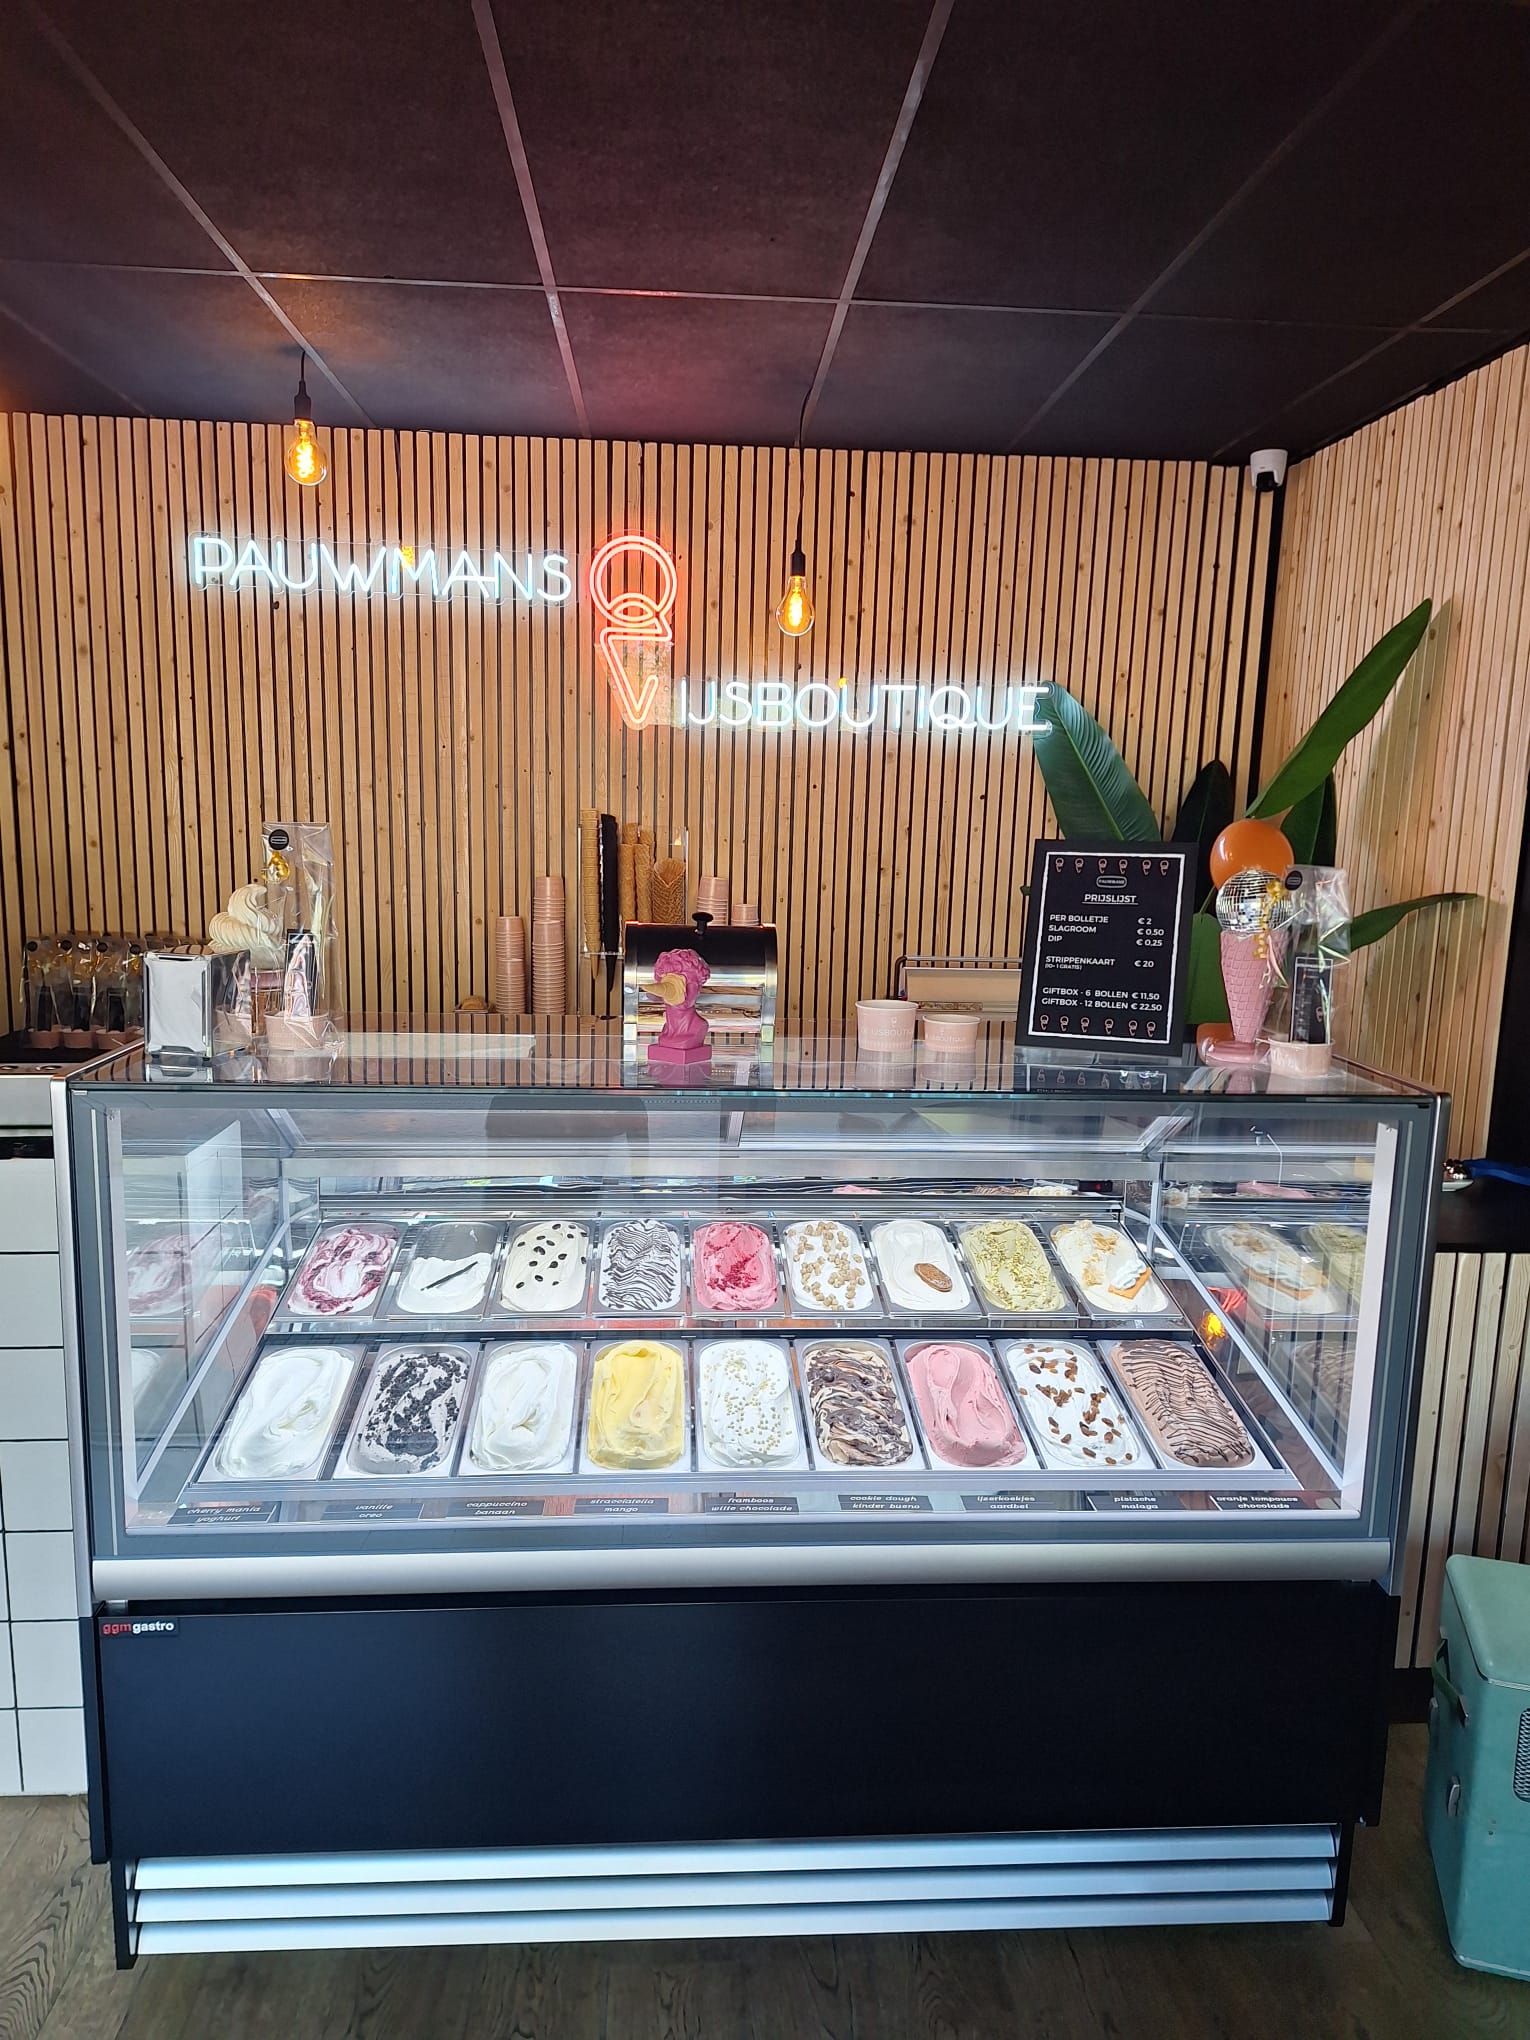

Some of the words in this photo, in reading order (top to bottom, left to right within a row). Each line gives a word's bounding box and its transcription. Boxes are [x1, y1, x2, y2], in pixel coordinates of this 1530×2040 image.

[192, 536, 573, 602] PAUWMANS
[680, 677, 1051, 732] IJSBOUTIQUE
[1084, 893, 1137, 903] PRIJSLIJST
[1068, 915, 1109, 923] BOLLETJE
[1048, 924, 1097, 933] SLAGROOM
[1045, 956, 1115, 965] STRIPPENKAART
[1042, 987, 1078, 996] GIFTBOX
[1095, 990, 1128, 999] BOLLEN
[1041, 998, 1078, 1006] GIFTBOX
[1095, 1000, 1128, 1009] BOLLEN
[196, 1515, 240, 1523] yoghurt
